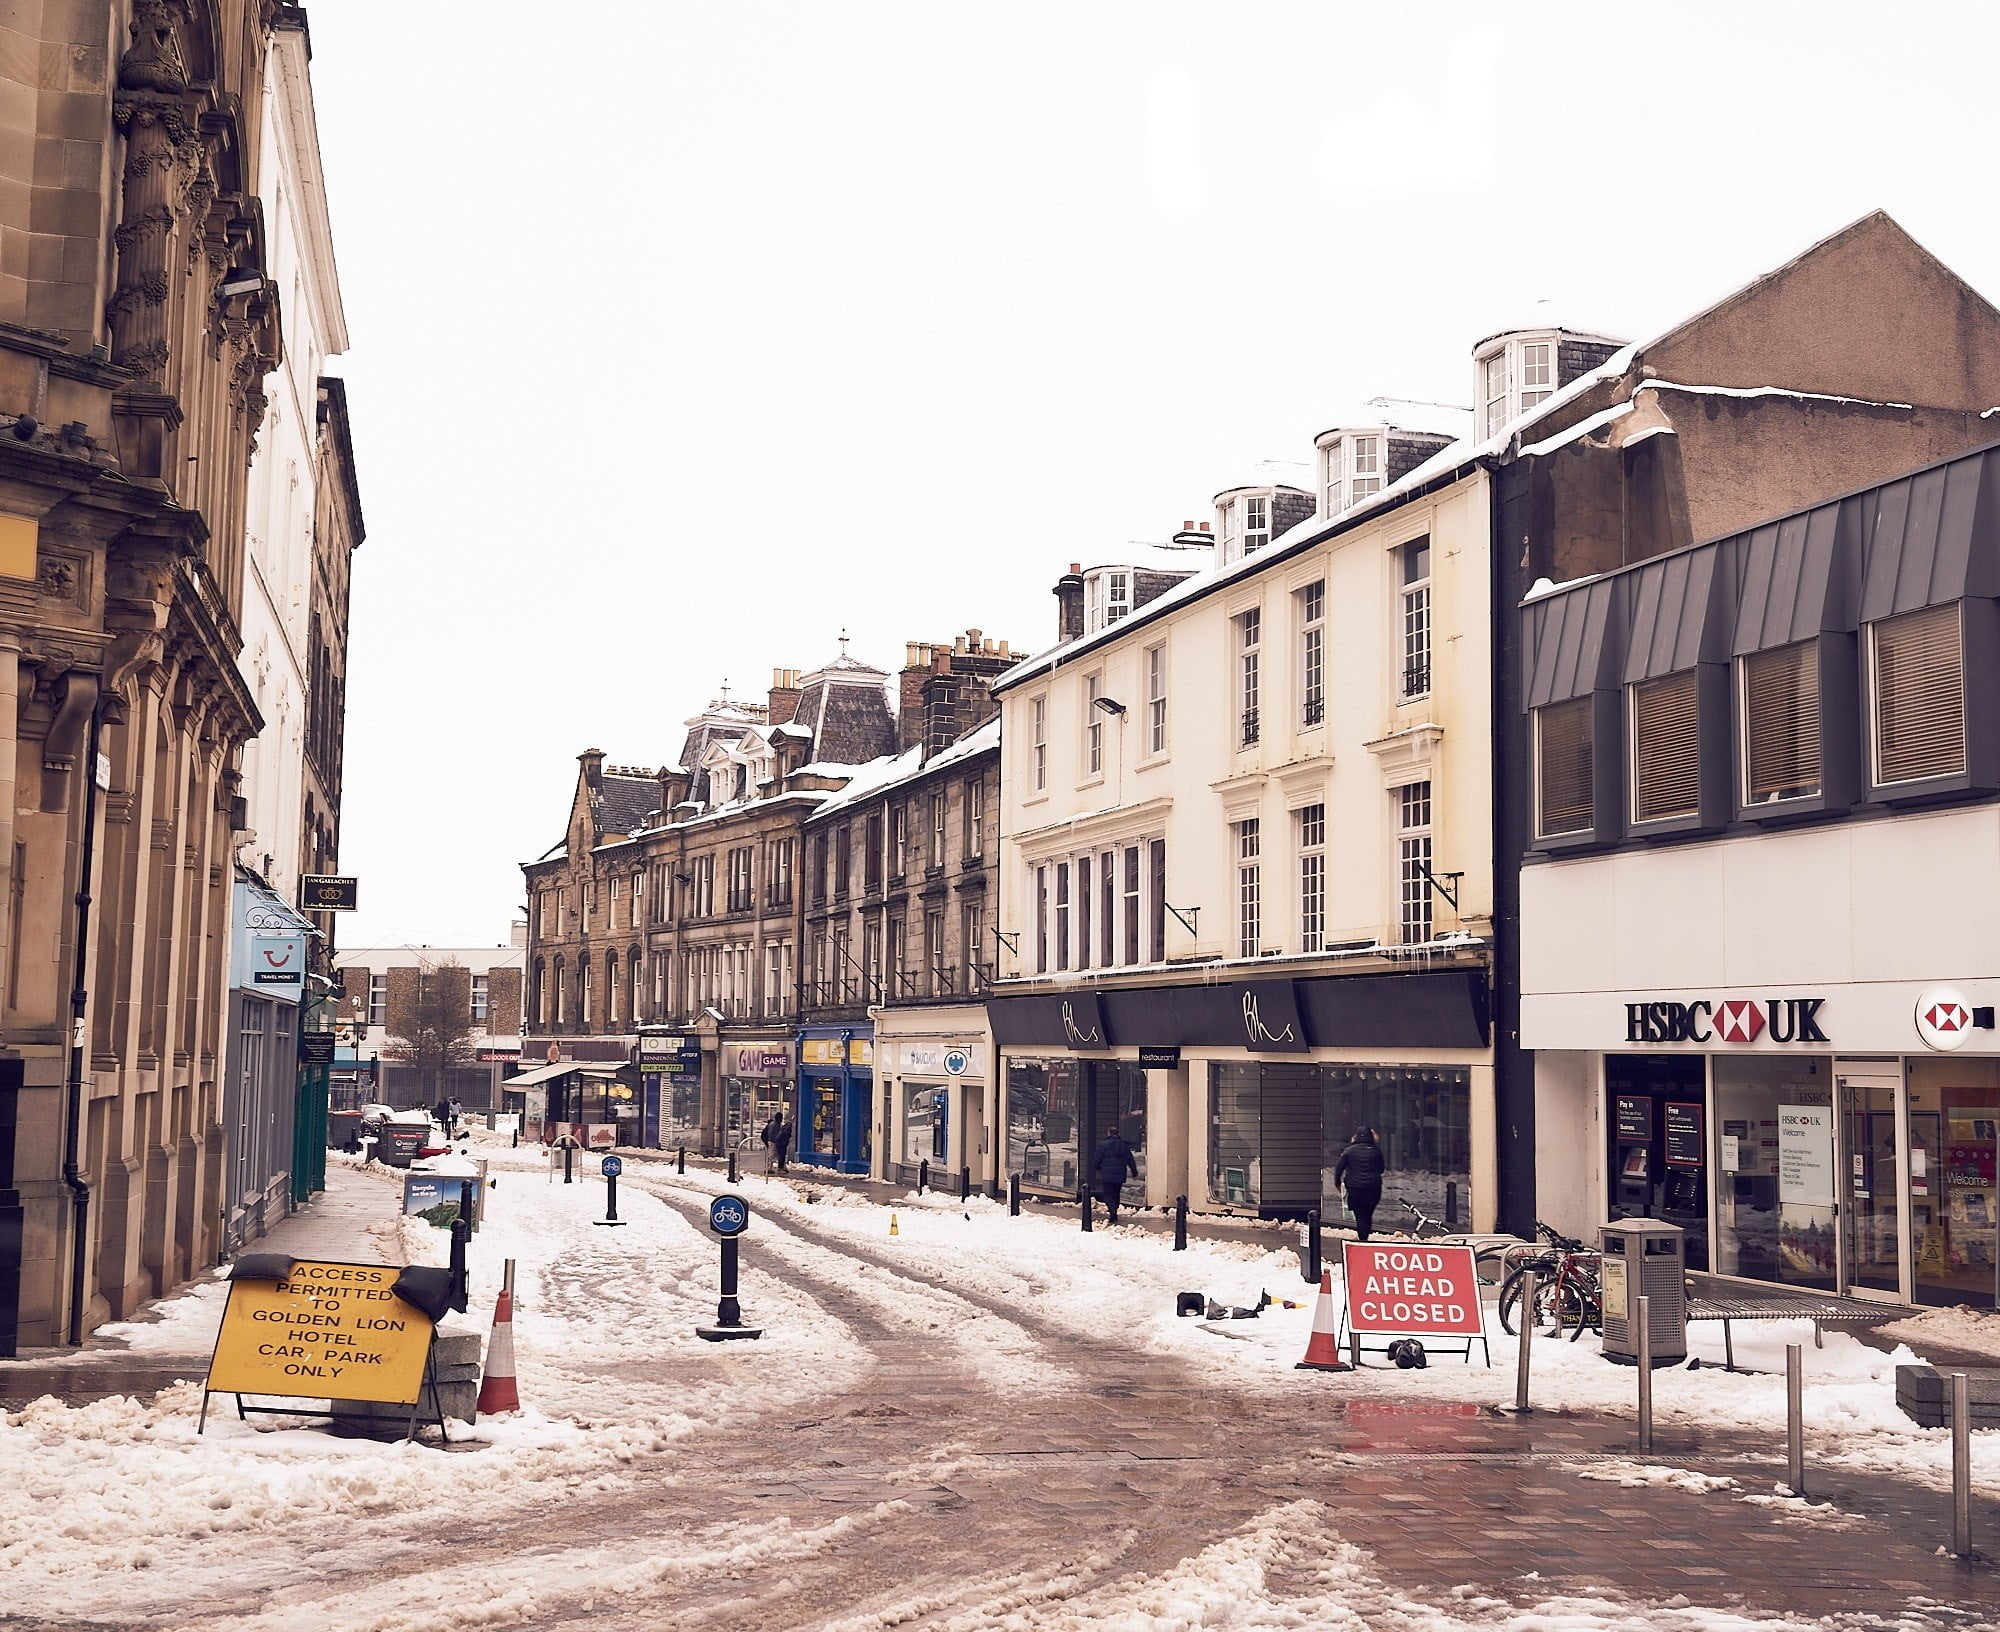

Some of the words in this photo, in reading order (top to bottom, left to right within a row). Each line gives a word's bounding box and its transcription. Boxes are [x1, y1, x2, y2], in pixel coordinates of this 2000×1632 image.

[1062, 1000, 1098, 1042] Bhs
[1243, 990, 1294, 1042] Bhs
[1625, 1001, 1712, 1042] HSBC
[1765, 998, 1831, 1043] UK
[642, 1038, 659, 1048] TO
[666, 1039, 684, 1048] LET
[762, 1056, 787, 1065] GAME
[1620, 1100, 1628, 1109] Pay
[1668, 1106, 1678, 1114] Free
[1782, 1116, 1798, 1124] HSBC
[1810, 1116, 1821, 1126] UK
[1783, 1128, 1806, 1136] Welcome
[1946, 1172, 1988, 1187] Welcome
[1373, 1252, 1443, 1272] ROAD
[293, 1266, 383, 1284] ACCESS
[276, 1283, 392, 1301] PERMITTED
[1365, 1276, 1454, 1297] AHEAD
[312, 1300, 340, 1312] TO
[1360, 1302, 1466, 1323] CLOSED
[252, 1310, 341, 1327] GOLDEN
[356, 1318, 406, 1332] LION
[288, 1330, 358, 1346] HOTEL
[258, 1344, 304, 1358] CAR
[324, 1350, 383, 1365] PARK
[284, 1364, 344, 1378] ONLY
